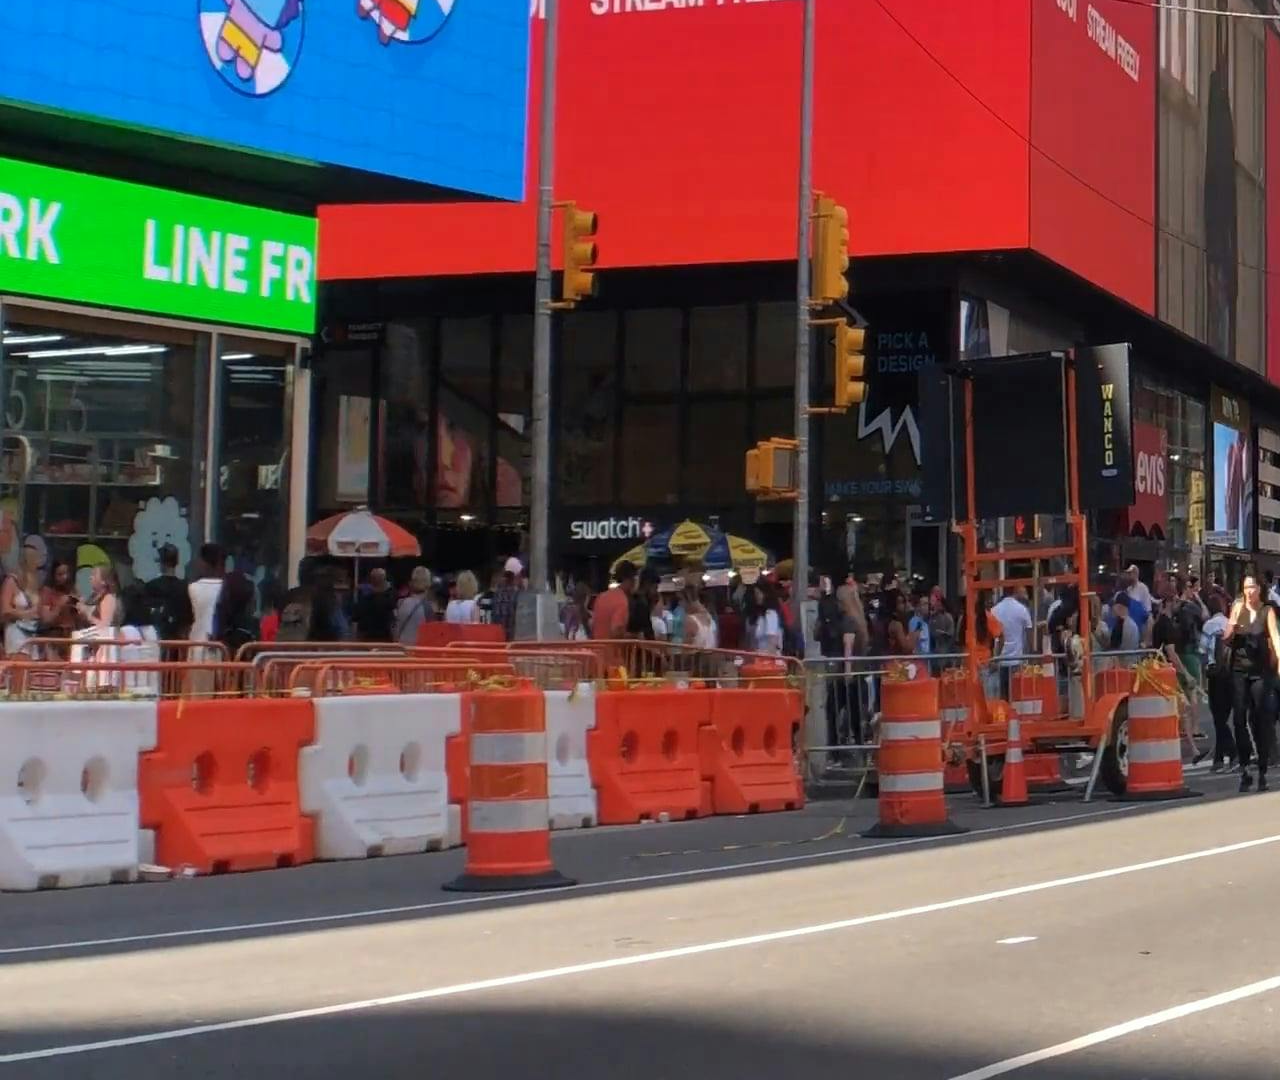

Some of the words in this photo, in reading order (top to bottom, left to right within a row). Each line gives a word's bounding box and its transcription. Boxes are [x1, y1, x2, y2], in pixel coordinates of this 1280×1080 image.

[144, 219, 248, 294] LINE
[259, 237, 312, 304] FR
[1101, 384, 1113, 466] WANCO
[571, 517, 641, 540] swatch
